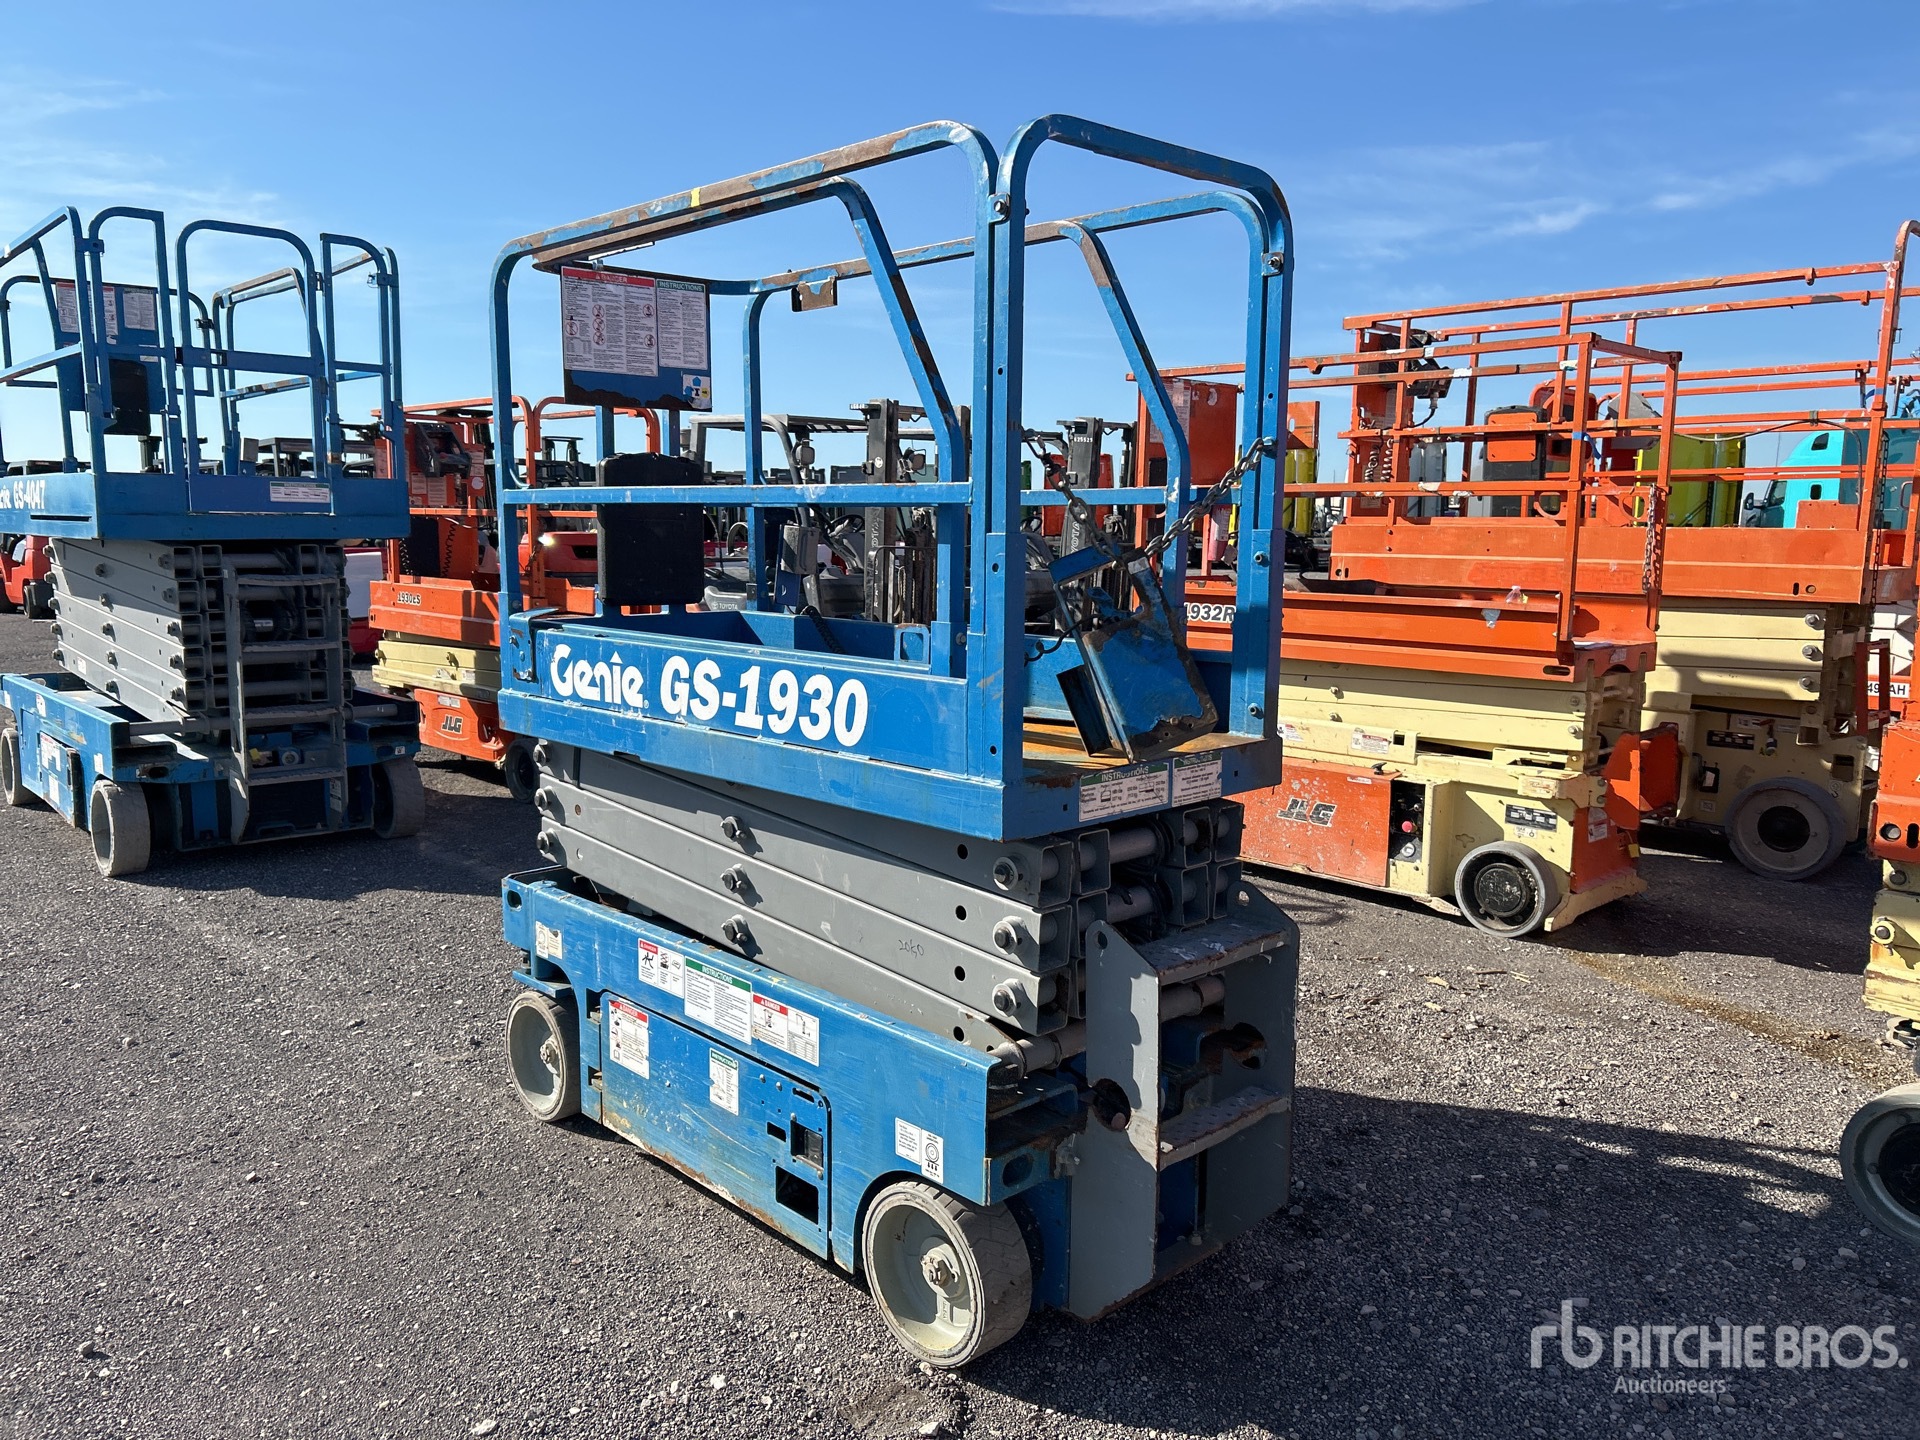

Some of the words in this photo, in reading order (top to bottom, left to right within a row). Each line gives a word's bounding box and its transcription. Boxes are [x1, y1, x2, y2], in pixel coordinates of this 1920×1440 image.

[600, 273, 628, 283] DANGER
[659, 281, 703, 292] INSTRUCTIONS
[13, 480, 45, 509] GS-4047
[719, 602, 738, 610] TOYOTA
[550, 643, 644, 709] Genie
[660, 655, 868, 747] GS-1930
[441, 714, 463, 734] JLG
[1276, 797, 1337, 827] JLG
[702, 966, 733, 984] INSTRUCTIONS
